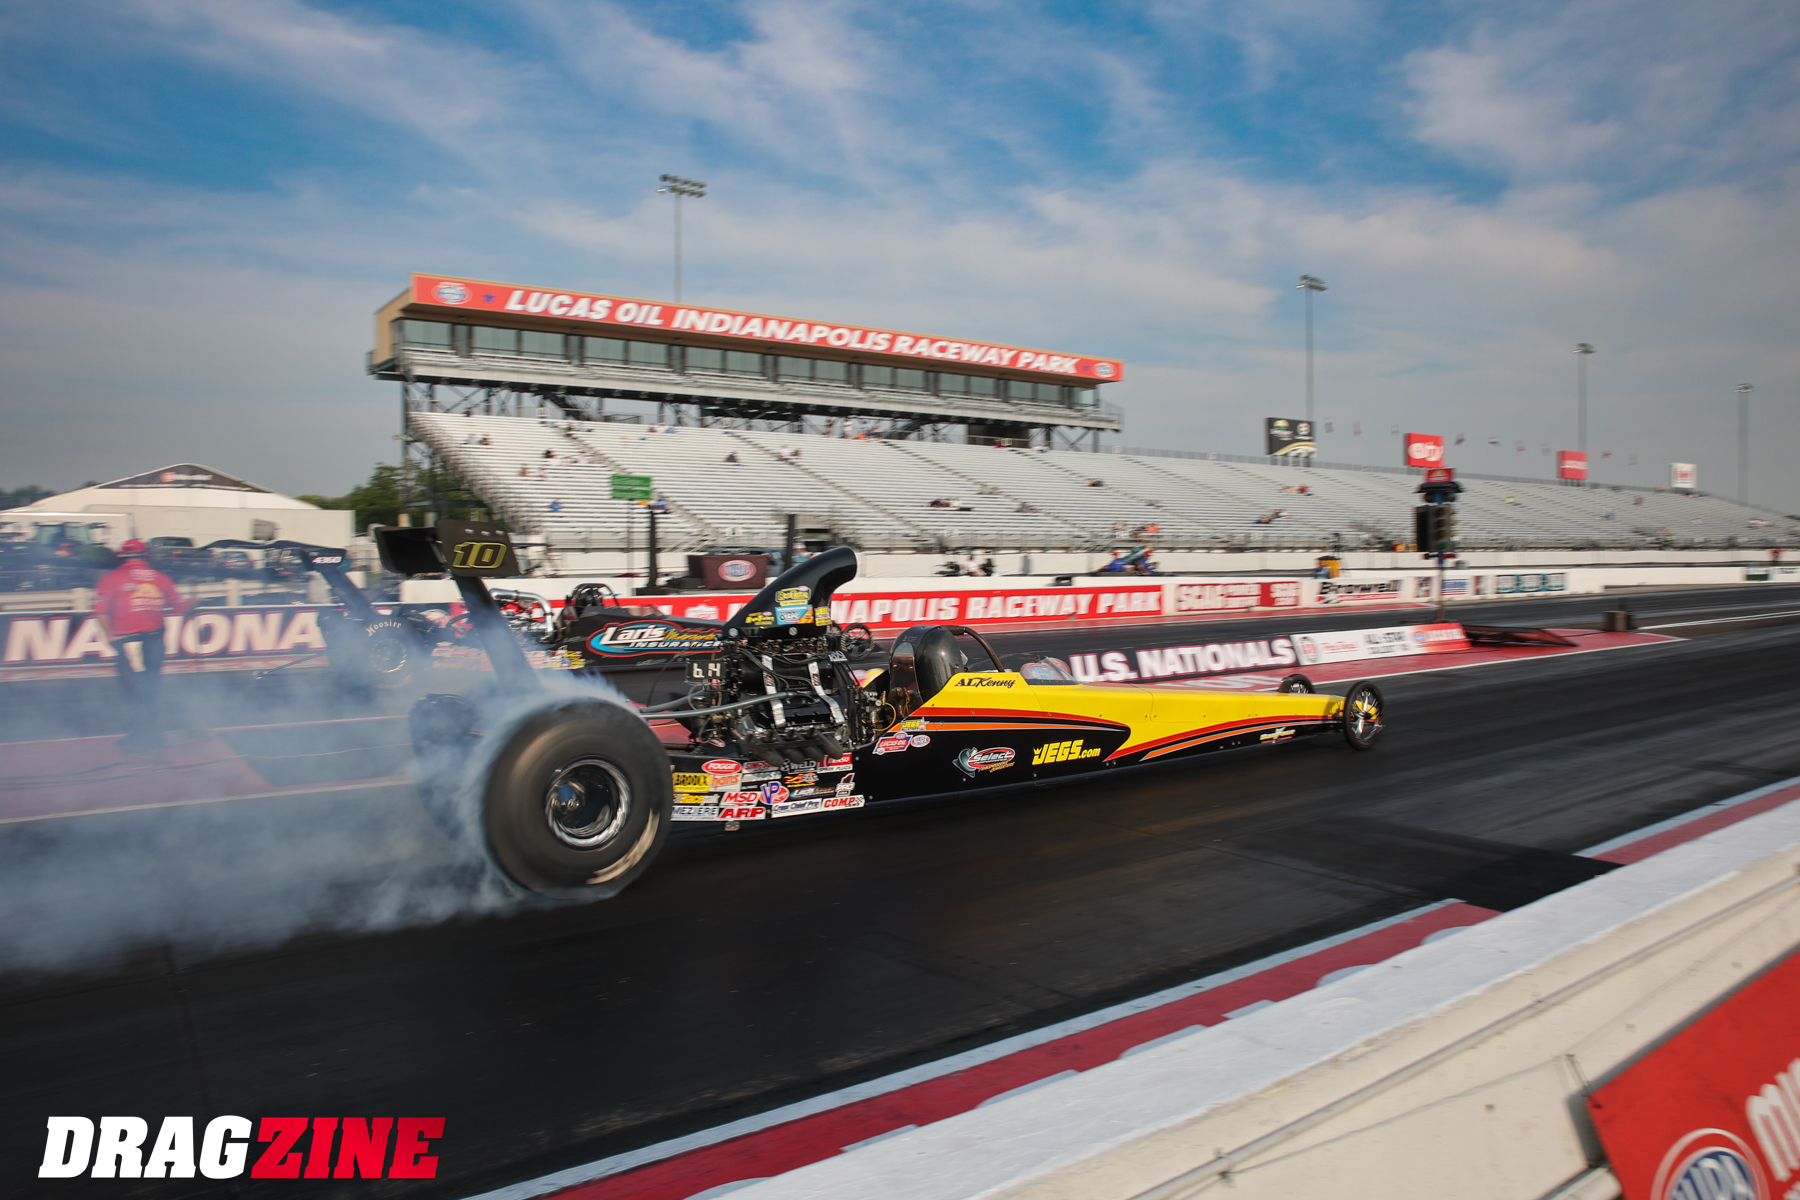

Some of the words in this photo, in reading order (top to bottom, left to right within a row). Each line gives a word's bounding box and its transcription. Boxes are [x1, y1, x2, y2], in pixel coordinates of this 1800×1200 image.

[503, 290, 613, 320] LUCAS
[614, 302, 665, 326] OIL
[670, 308, 893, 351] INDIANAPOLIS
[892, 335, 1019, 366] RACEWAY
[1016, 351, 1081, 374] PARK
[452, 542, 507, 568] 10
[965, 594, 1093, 620] RACEWAY
[1098, 590, 1163, 614] PARK
[1069, 651, 1138, 683] U.S.
[1136, 637, 1297, 680] NATIONALS
[972, 751, 1014, 762] Select
[1032, 739, 1101, 765] JEGS.com
[724, 792, 758, 803] MSD
[823, 797, 856, 808] COMP
[720, 807, 765, 818] ARP
